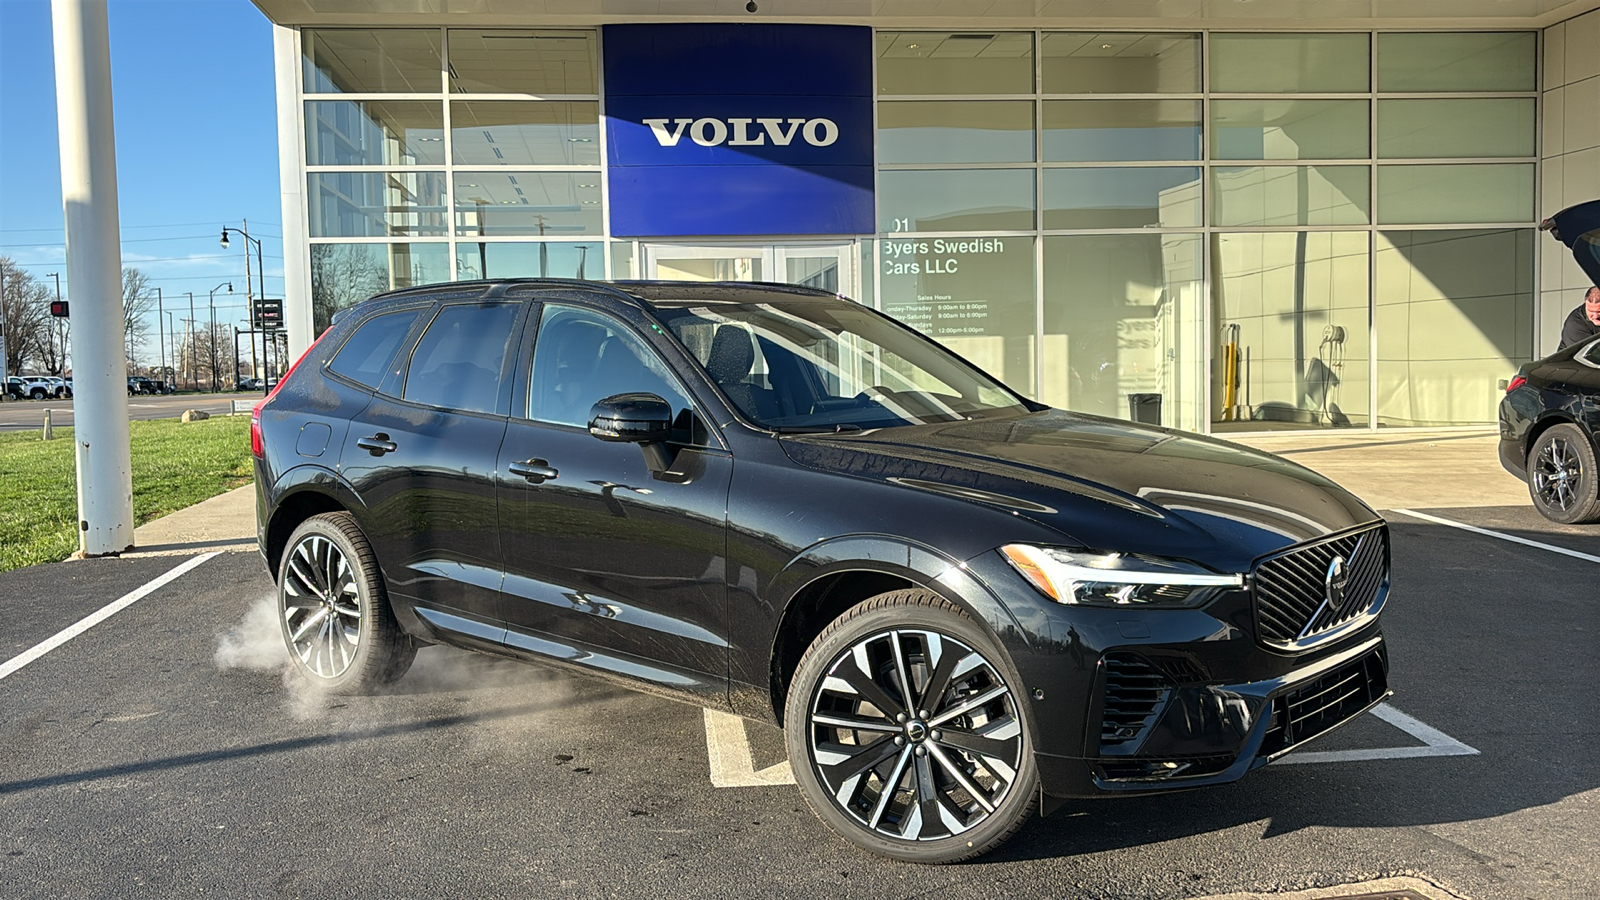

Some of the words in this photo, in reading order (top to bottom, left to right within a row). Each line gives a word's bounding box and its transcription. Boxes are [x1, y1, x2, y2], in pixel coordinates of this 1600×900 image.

[642, 117, 839, 147] VOLVO
[883, 241, 929, 258] Byers
[934, 239, 1004, 254] Swedish
[883, 260, 920, 275] Cars
[925, 259, 958, 274] LLC
